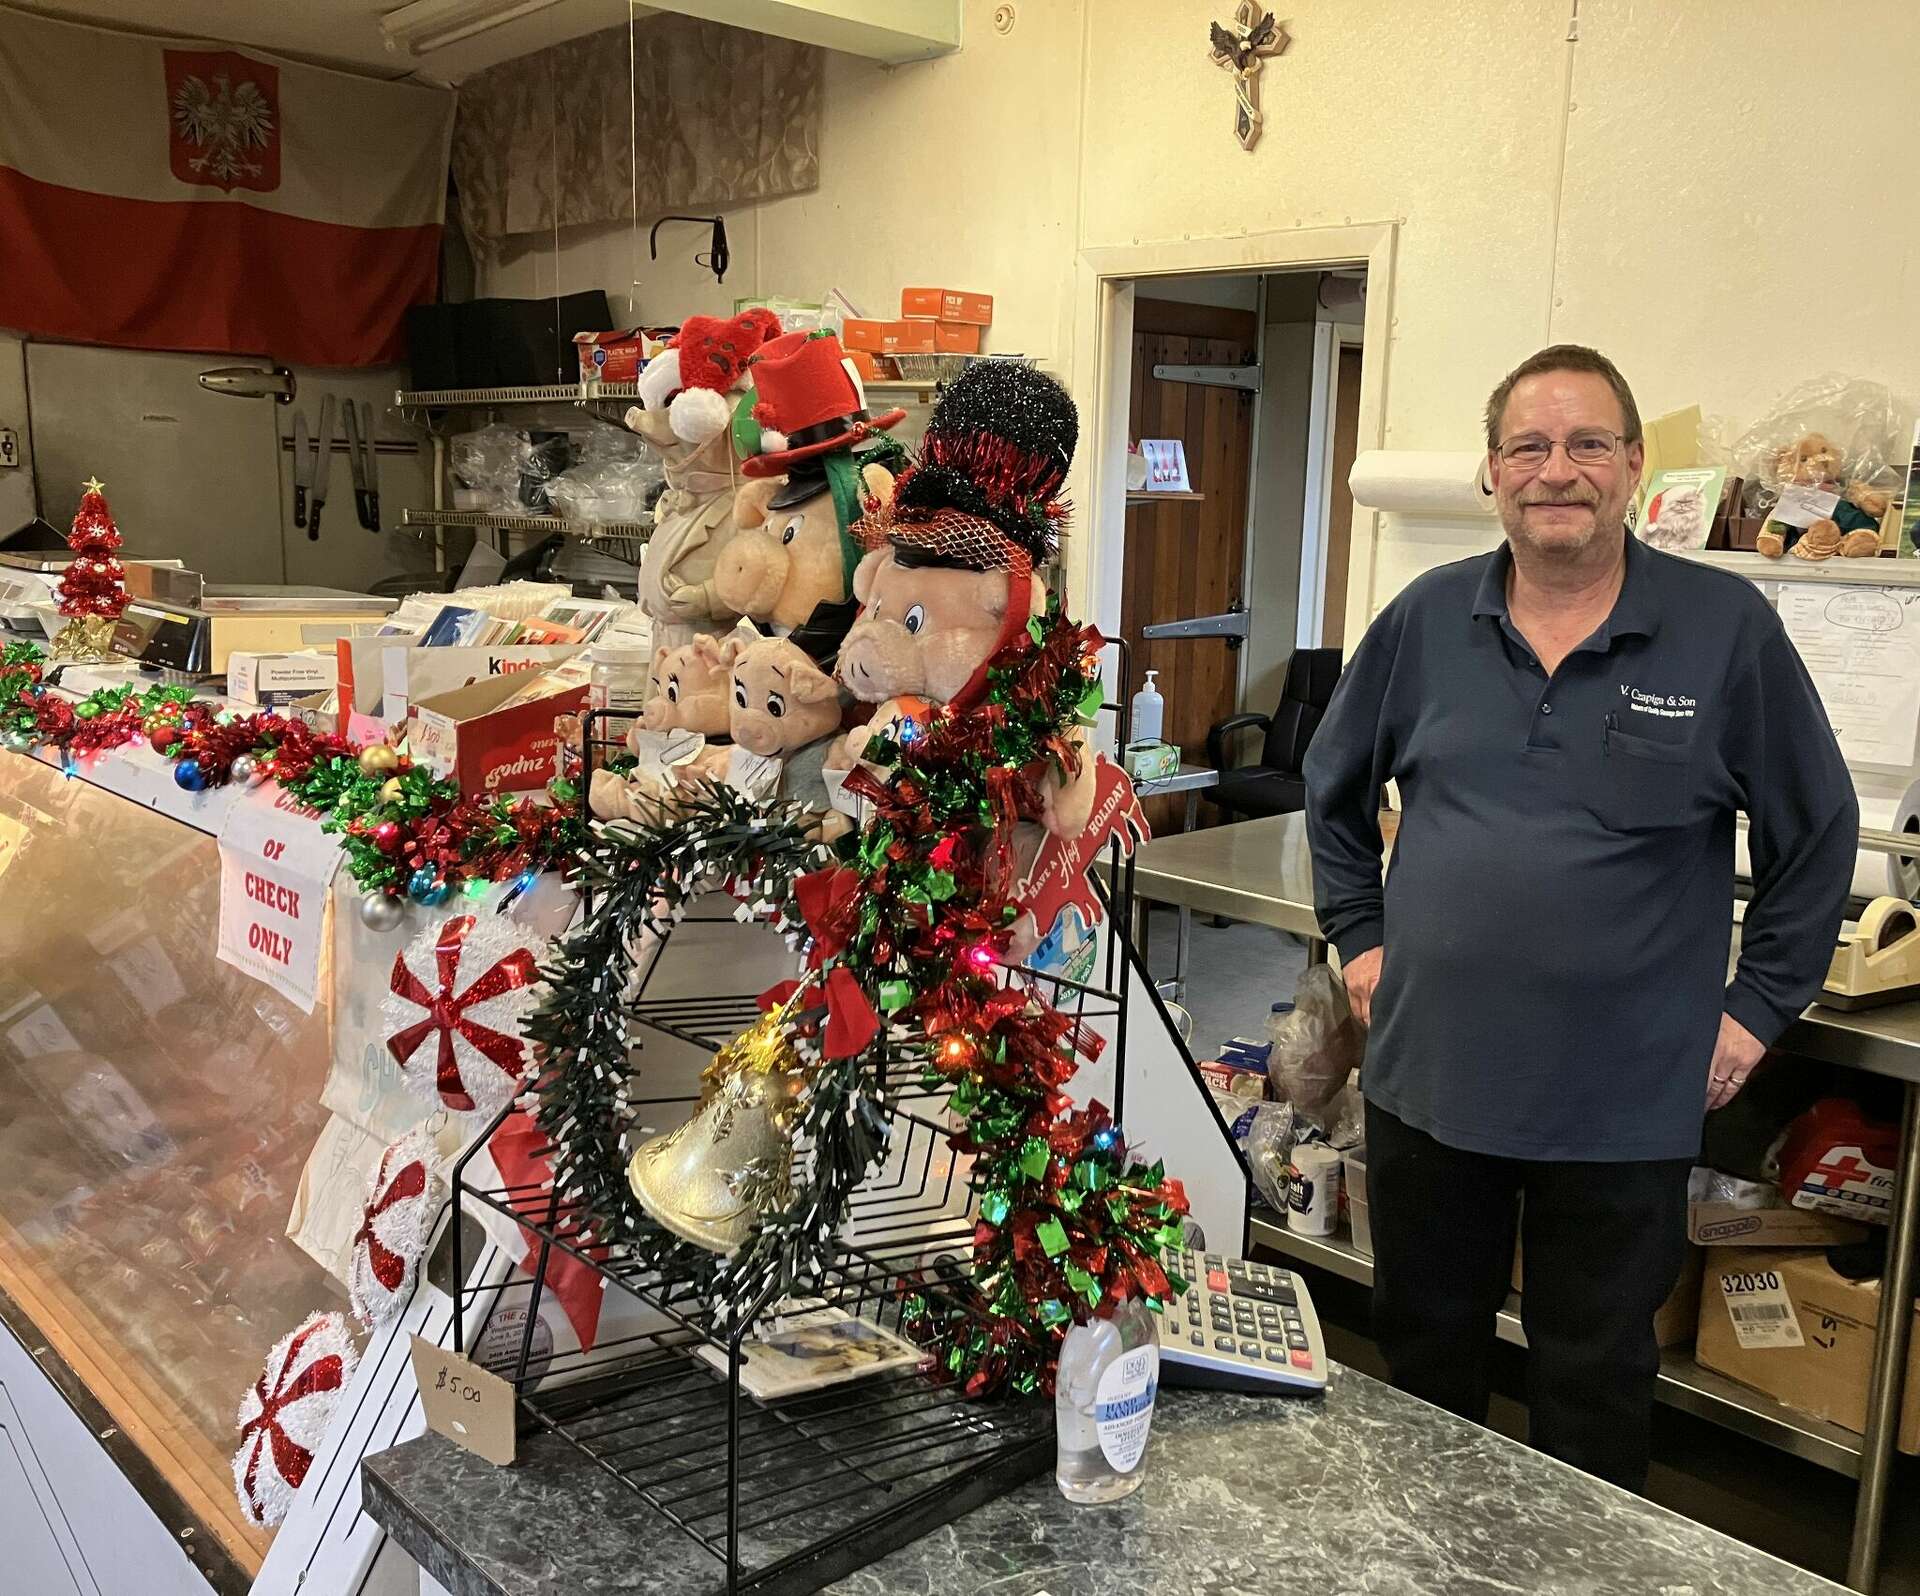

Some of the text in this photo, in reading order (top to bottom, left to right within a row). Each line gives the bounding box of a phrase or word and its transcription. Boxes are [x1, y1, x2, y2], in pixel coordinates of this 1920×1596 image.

[1620, 684, 1696, 707] V. Czapiga & Son
[1028, 868, 1052, 899] HAVE
[1057, 840, 1081, 889] Hog
[1088, 781, 1126, 837] HOLIDAY
[245, 871, 300, 919] CHECK
[248, 922, 292, 966] ONLY
[1203, 1077, 1229, 1090] ACK
[1721, 1271, 1779, 1293] 32030
[498, 1312, 515, 1322] THE
[435, 1366, 481, 1402] $5.00
[1106, 1398, 1137, 1413] HAND
